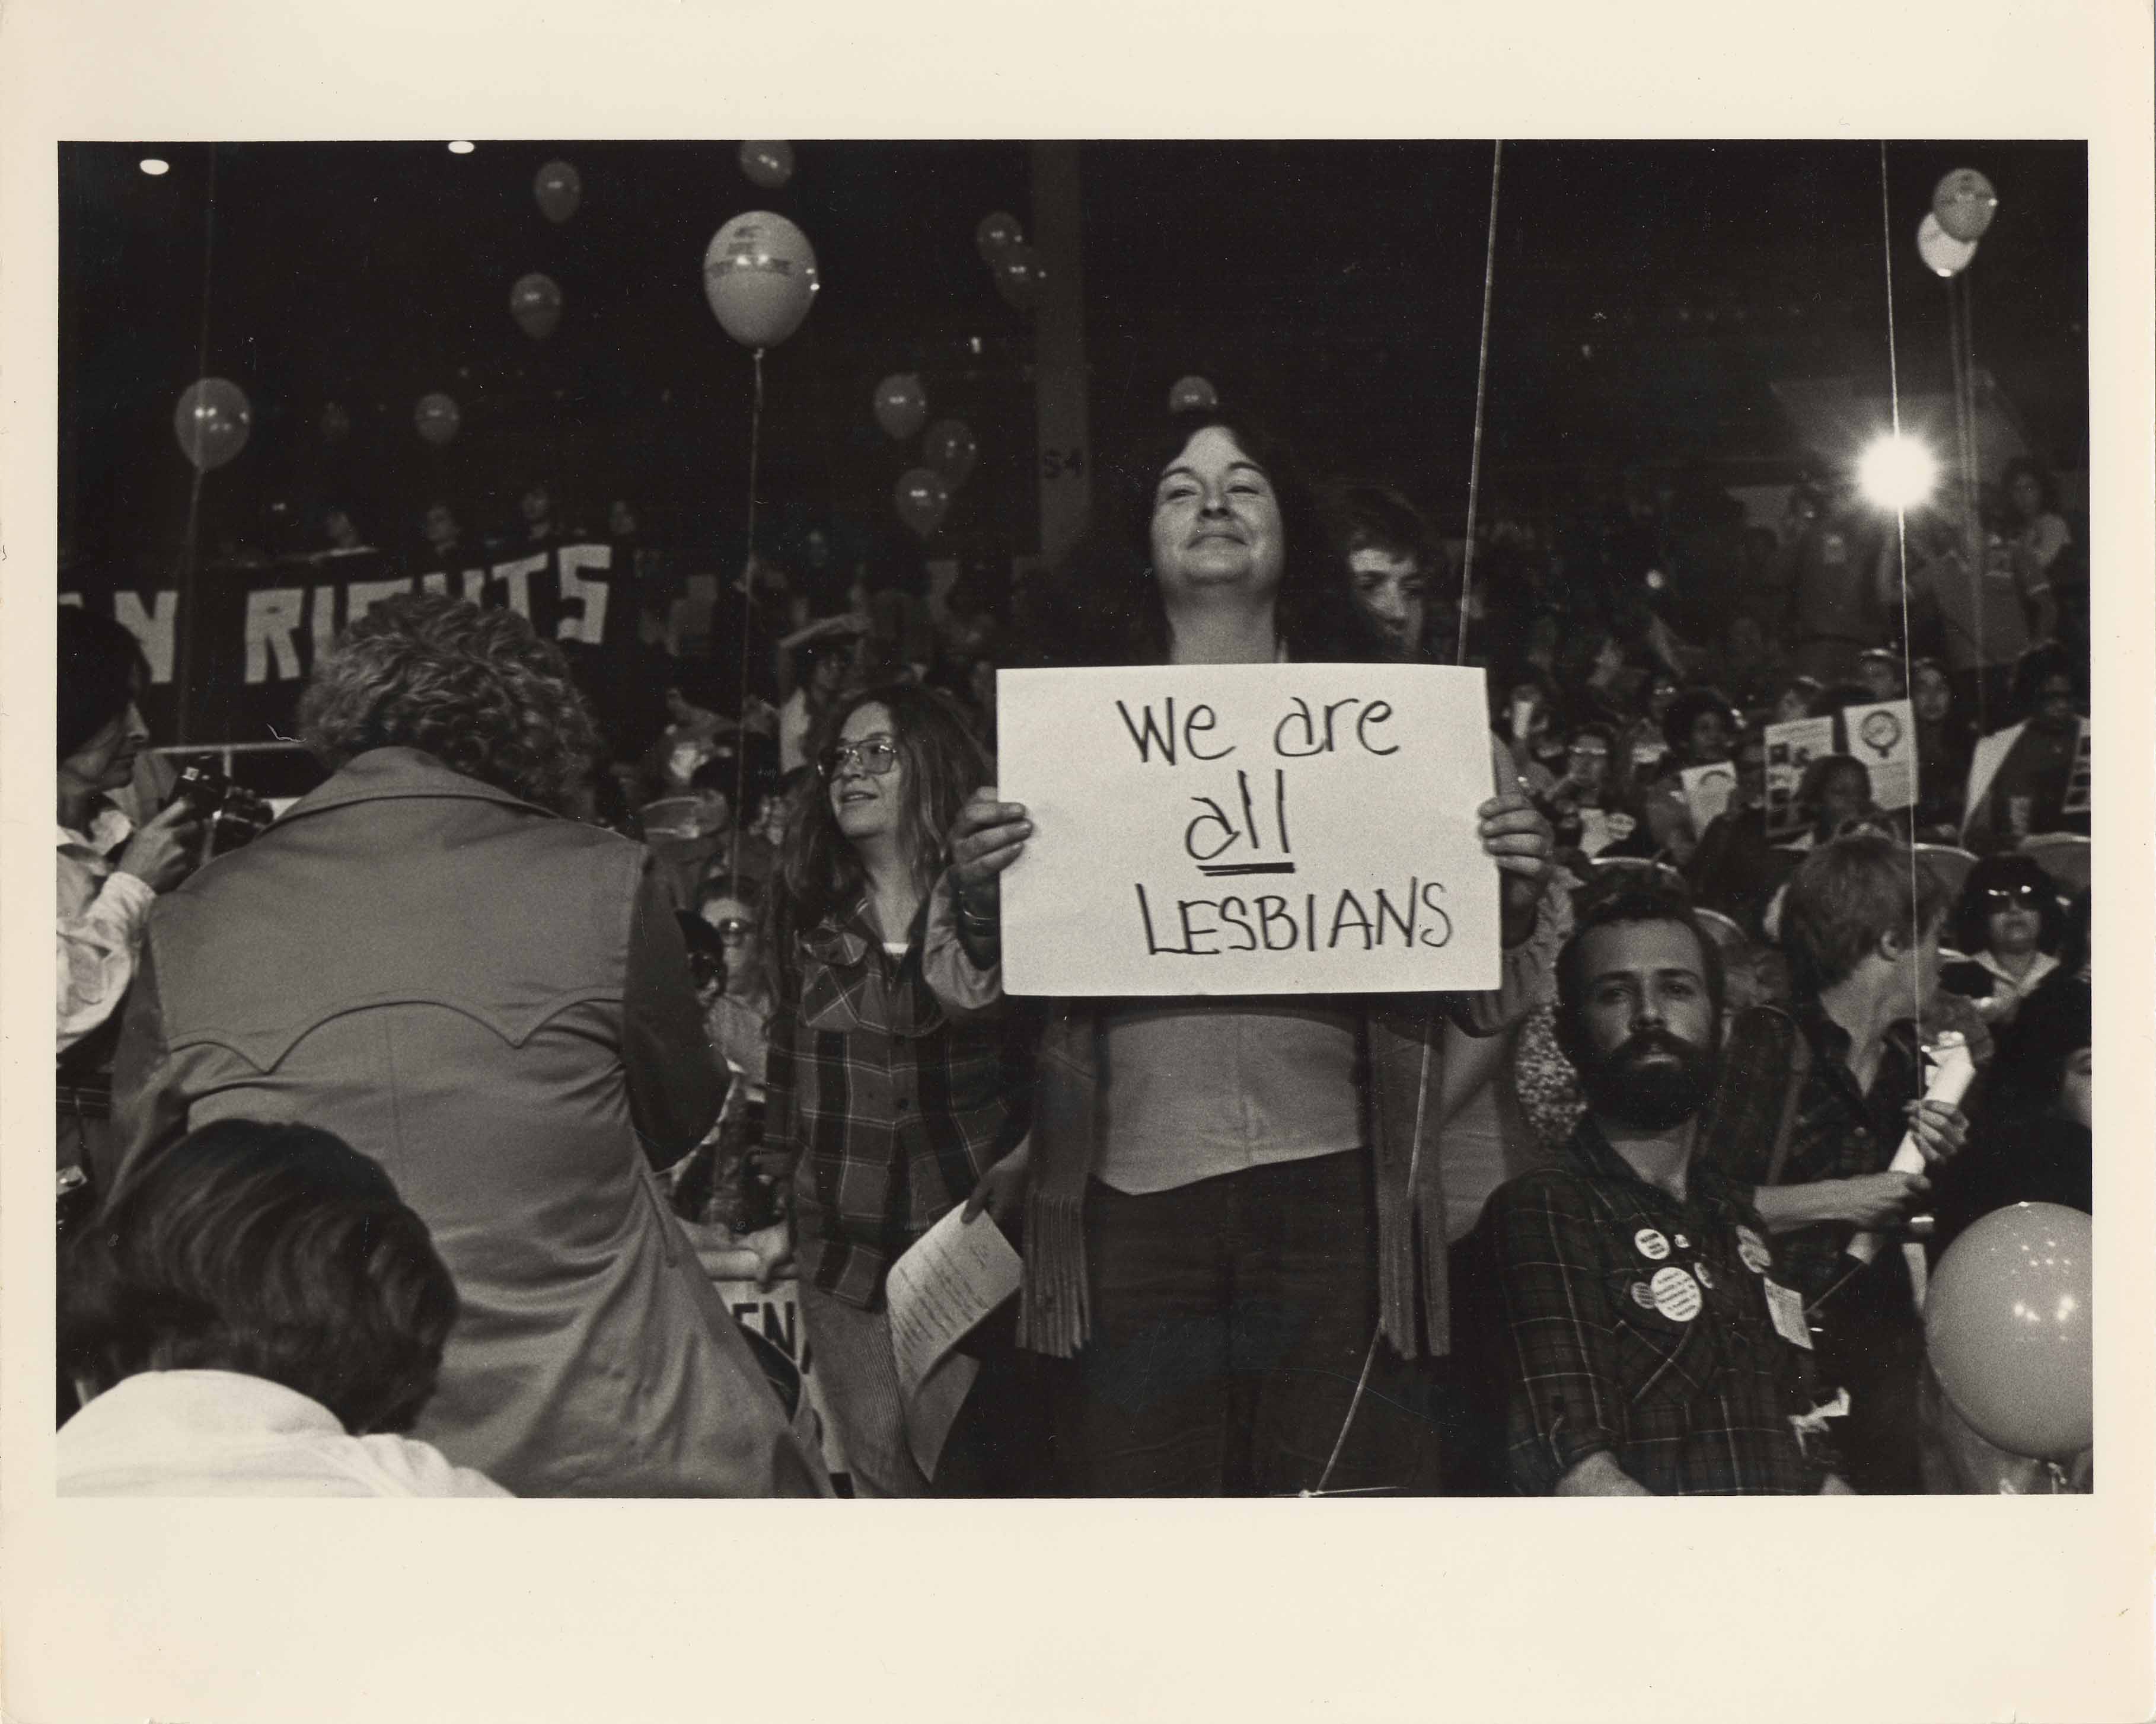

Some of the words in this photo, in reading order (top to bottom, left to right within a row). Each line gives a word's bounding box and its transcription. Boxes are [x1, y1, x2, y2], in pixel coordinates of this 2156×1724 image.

[245, 544, 611, 684] RITS
[1116, 697, 1236, 766] We
[1274, 697, 1401, 757] are
[1185, 769, 1290, 860] all
[1134, 876, 1452, 956] LESBIANS
